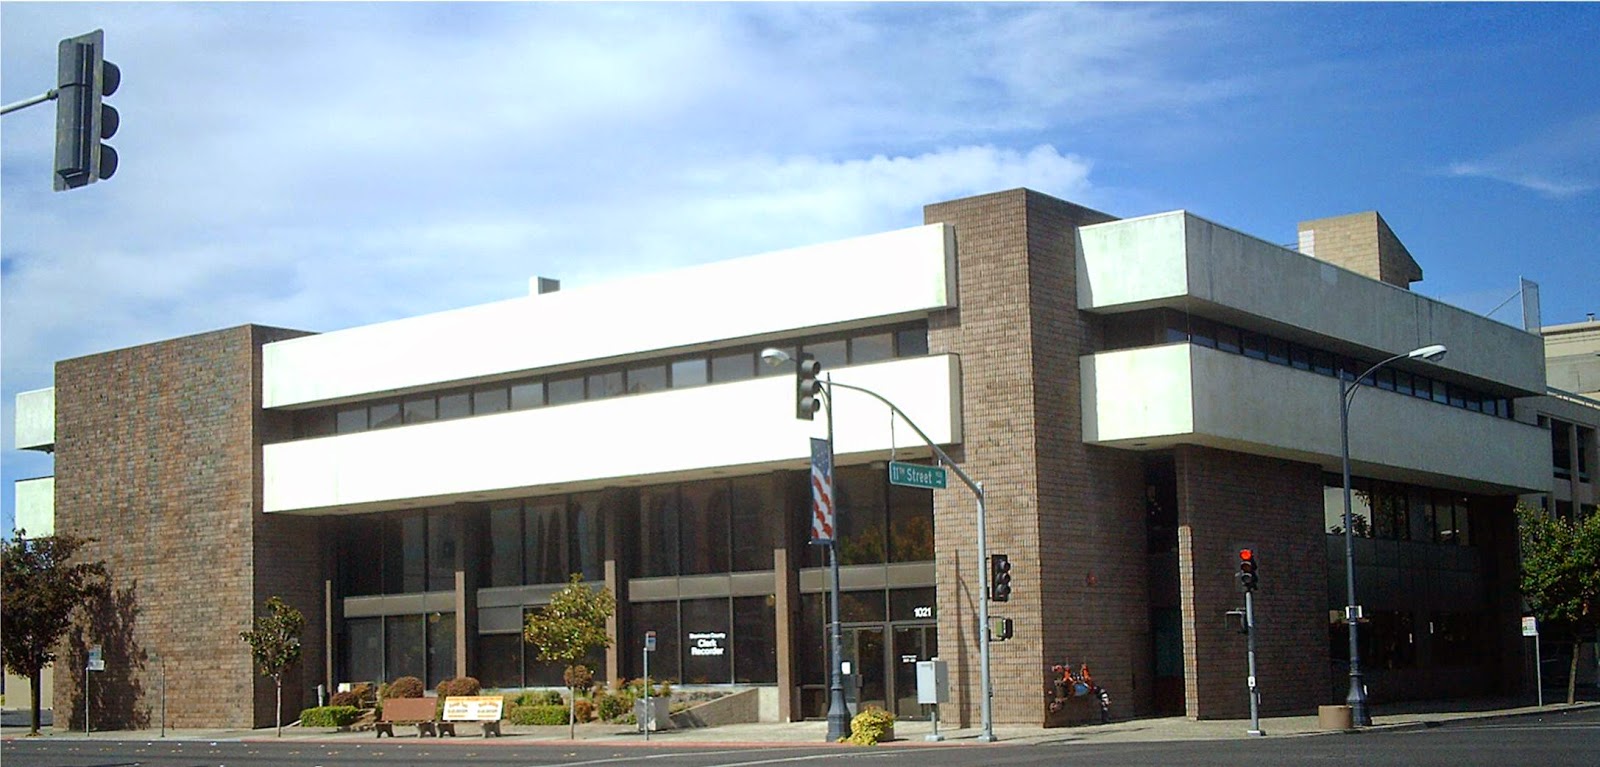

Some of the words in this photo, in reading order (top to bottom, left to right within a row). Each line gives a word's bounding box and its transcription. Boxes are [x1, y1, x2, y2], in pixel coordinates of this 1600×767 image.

[906, 468, 932, 484] Street
[914, 607, 931, 617] 1021
[691, 647, 723, 655] Recorder
